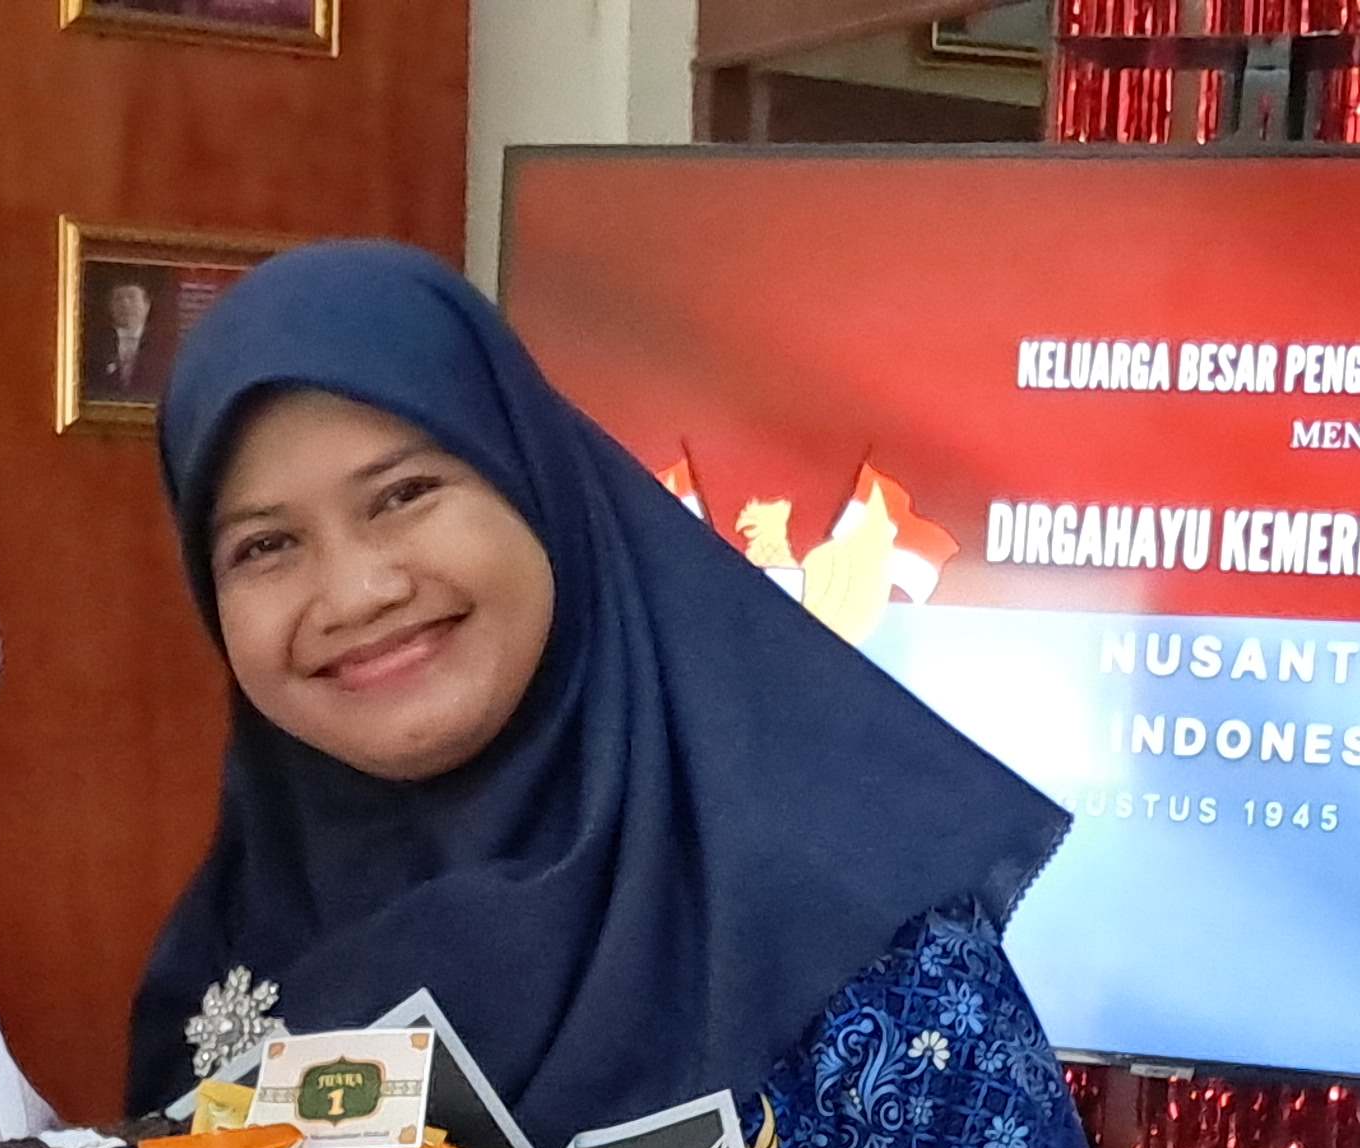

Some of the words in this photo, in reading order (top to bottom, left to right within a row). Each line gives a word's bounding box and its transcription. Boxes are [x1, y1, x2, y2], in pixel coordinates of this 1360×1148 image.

[1016, 339, 1171, 391] KELUARGA
[1178, 342, 1278, 393] BESAR
[985, 502, 1212, 571] DIRGAHAYU
[1060, 789, 1218, 825] USTUS
[1243, 799, 1339, 832] 1945
[327, 1088, 346, 1116] 1
